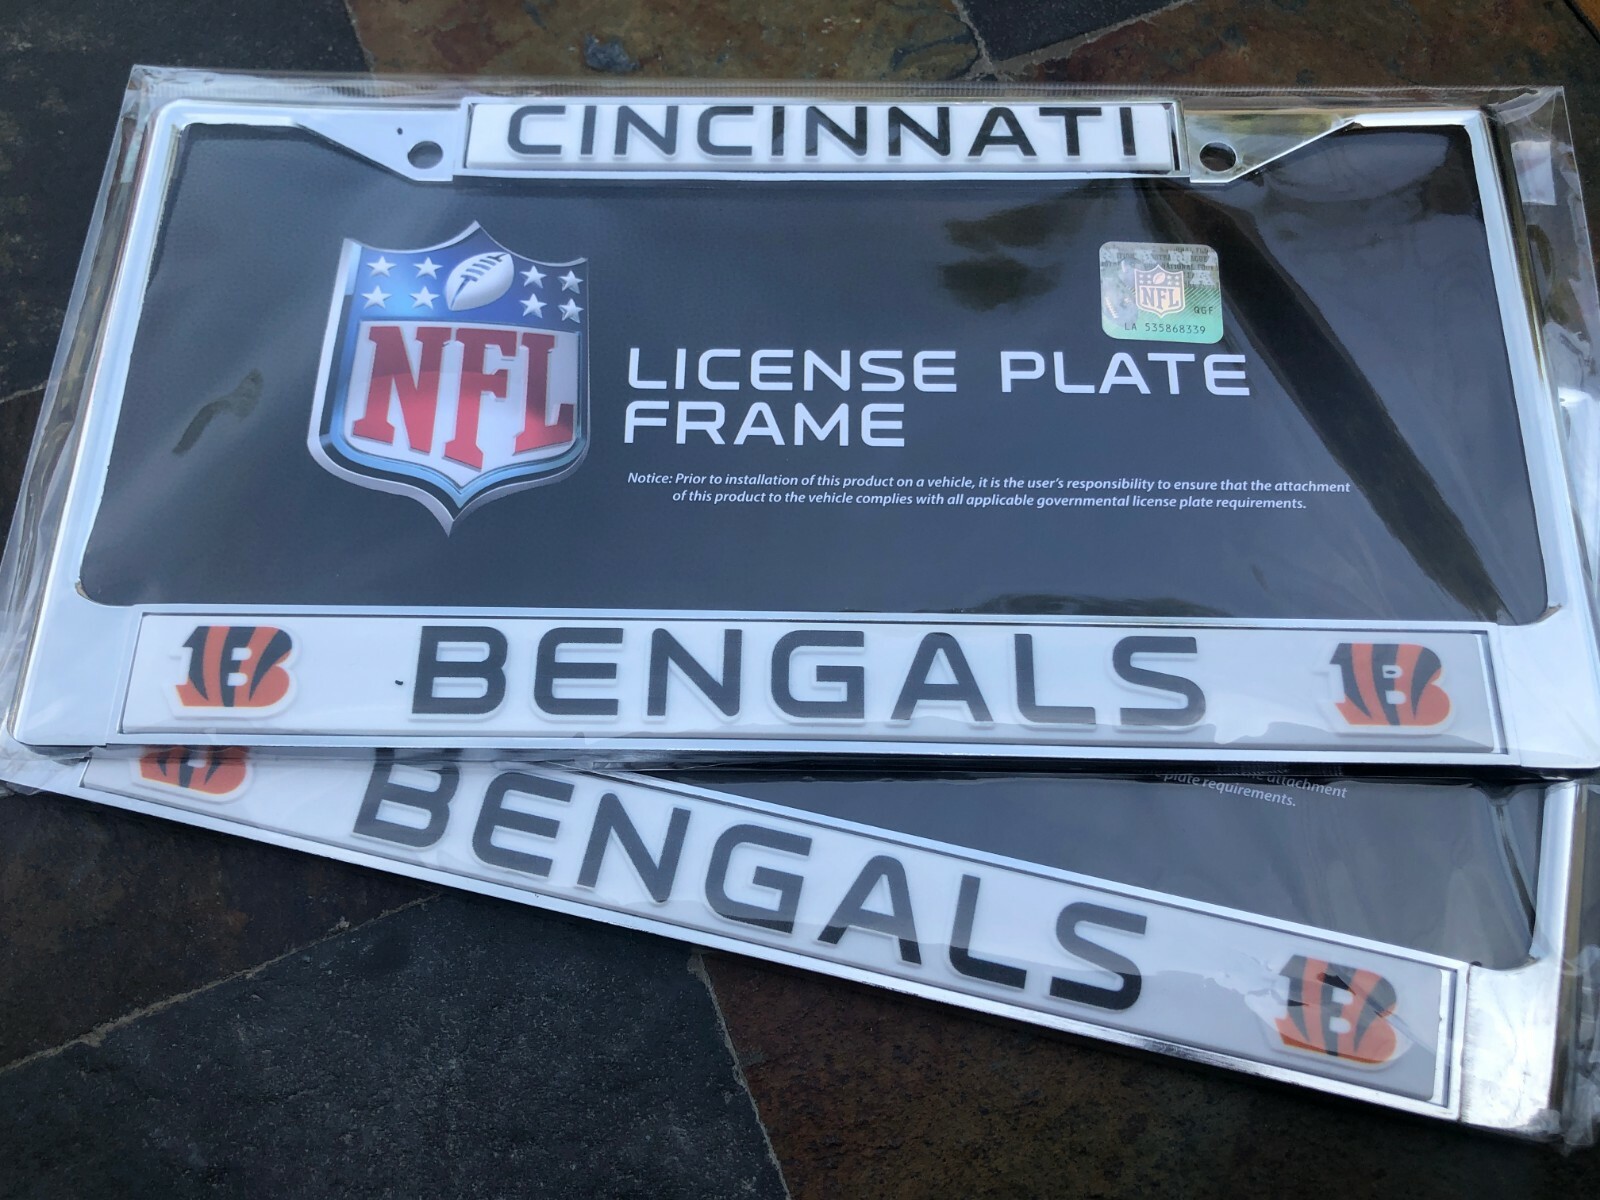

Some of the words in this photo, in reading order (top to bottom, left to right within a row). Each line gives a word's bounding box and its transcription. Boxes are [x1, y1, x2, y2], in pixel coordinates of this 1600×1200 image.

[506, 103, 1138, 160] CINCINNATI
[1140, 287, 1180, 310] NFL
[1124, 322, 1138, 331] LA
[1145, 323, 1206, 335] 535868339
[627, 347, 958, 394] LICENSE
[1000, 350, 1251, 397] PLATE
[351, 324, 576, 470] NFL
[623, 401, 906, 448] FRAME
[627, 471, 674, 484] Notice:
[674, 472, 708, 485] Prior
[708, 474, 723, 485] to
[724, 473, 799, 486] installation
[800, 473, 817, 487] of
[816, 473, 841, 487] this
[842, 474, 895, 489] product
[896, 478, 914, 488] on
[915, 478, 925, 488] a
[927, 475, 976, 490] vehicle,
[978, 476, 989, 488] it
[989, 476, 1001, 489] is
[1003, 476, 1025, 489] the
[1066, 477, 1156, 493] responsibility
[1157, 479, 1172, 490] to
[1173, 481, 1218, 491] ensure
[1220, 478, 1249, 491] that
[1250, 479, 1273, 492] the
[1274, 480, 1351, 493] attachment
[672, 489, 688, 502] of
[688, 489, 713, 502] this
[713, 490, 767, 505] product
[768, 492, 782, 503] to
[784, 490, 807, 503] the
[808, 491, 854, 504] vehicle
[855, 492, 913, 507] complies
[915, 492, 945, 505] with
[946, 493, 965, 505] all
[965, 493, 1035, 509] applicable
[1036, 494, 1131, 509] governmental
[1132, 494, 1178, 508] license
[1178, 495, 1214, 511] plate
[1215, 496, 1307, 511] requirements.
[411, 625, 1207, 728] BENGALS
[1201, 778, 1297, 807] requirements.
[352, 746, 1148, 1012] BENGALS
